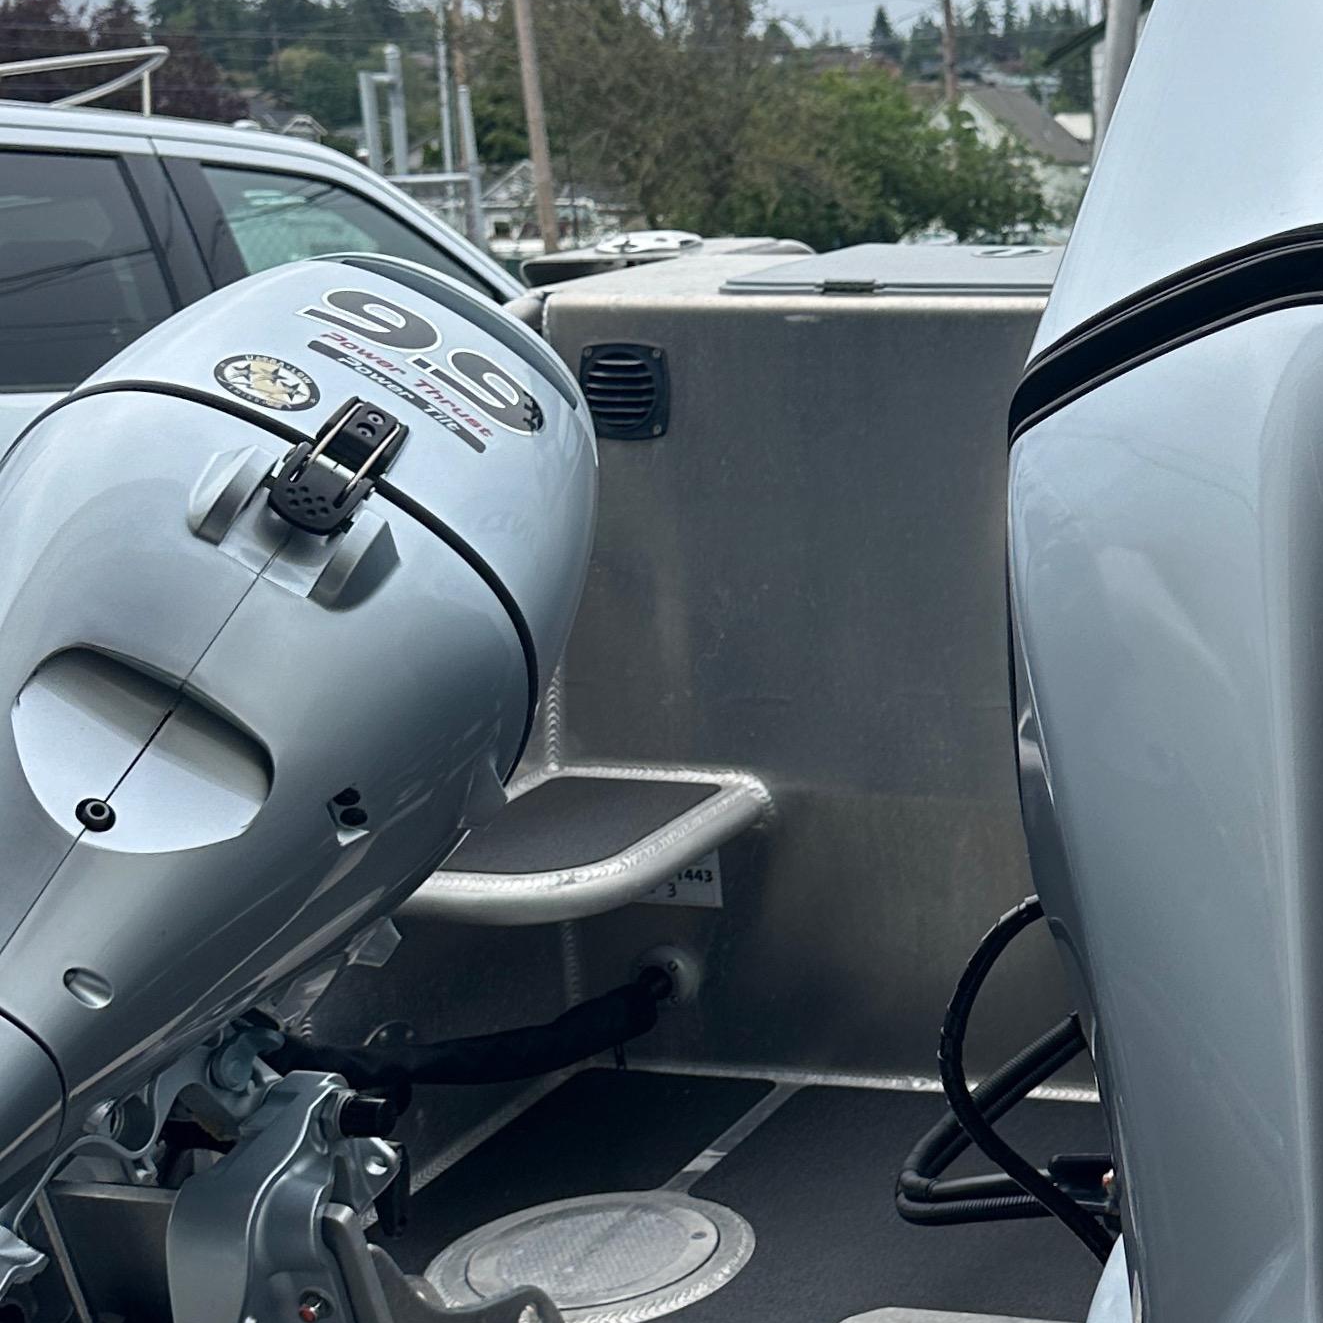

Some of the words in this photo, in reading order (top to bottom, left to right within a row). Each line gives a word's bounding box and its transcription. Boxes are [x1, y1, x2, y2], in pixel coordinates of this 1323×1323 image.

[296, 288, 546, 436] 9.9
[321, 331, 407, 376] Power
[414, 378, 494, 439] Thrust
[337, 355, 417, 401] Power
[421, 403, 463, 433] Tilt
